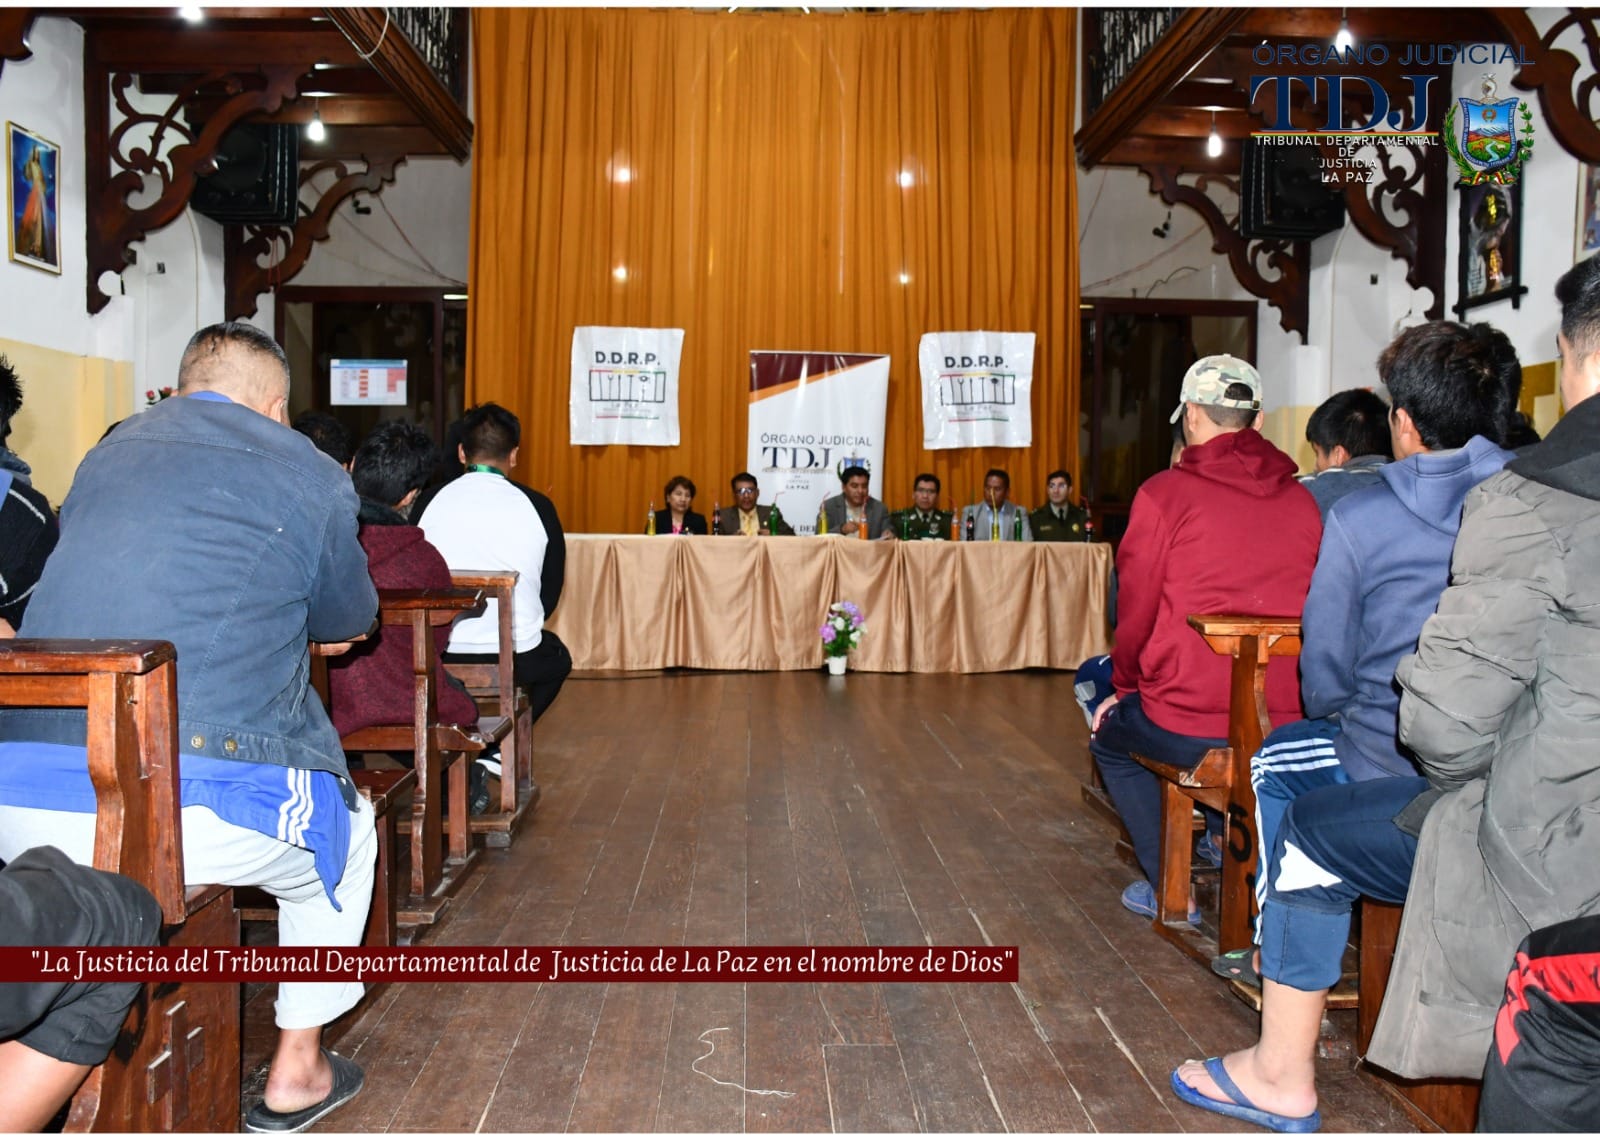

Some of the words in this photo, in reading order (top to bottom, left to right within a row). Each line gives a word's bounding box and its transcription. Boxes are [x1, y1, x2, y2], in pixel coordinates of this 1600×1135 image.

[594, 350, 661, 366] D.D.R.P.
[944, 355, 1009, 369] D.D.R.P.
[760, 432, 815, 445] ÓRGANO
[818, 434, 872, 447] JUDICIAL
[762, 446, 834, 469] TDJ
